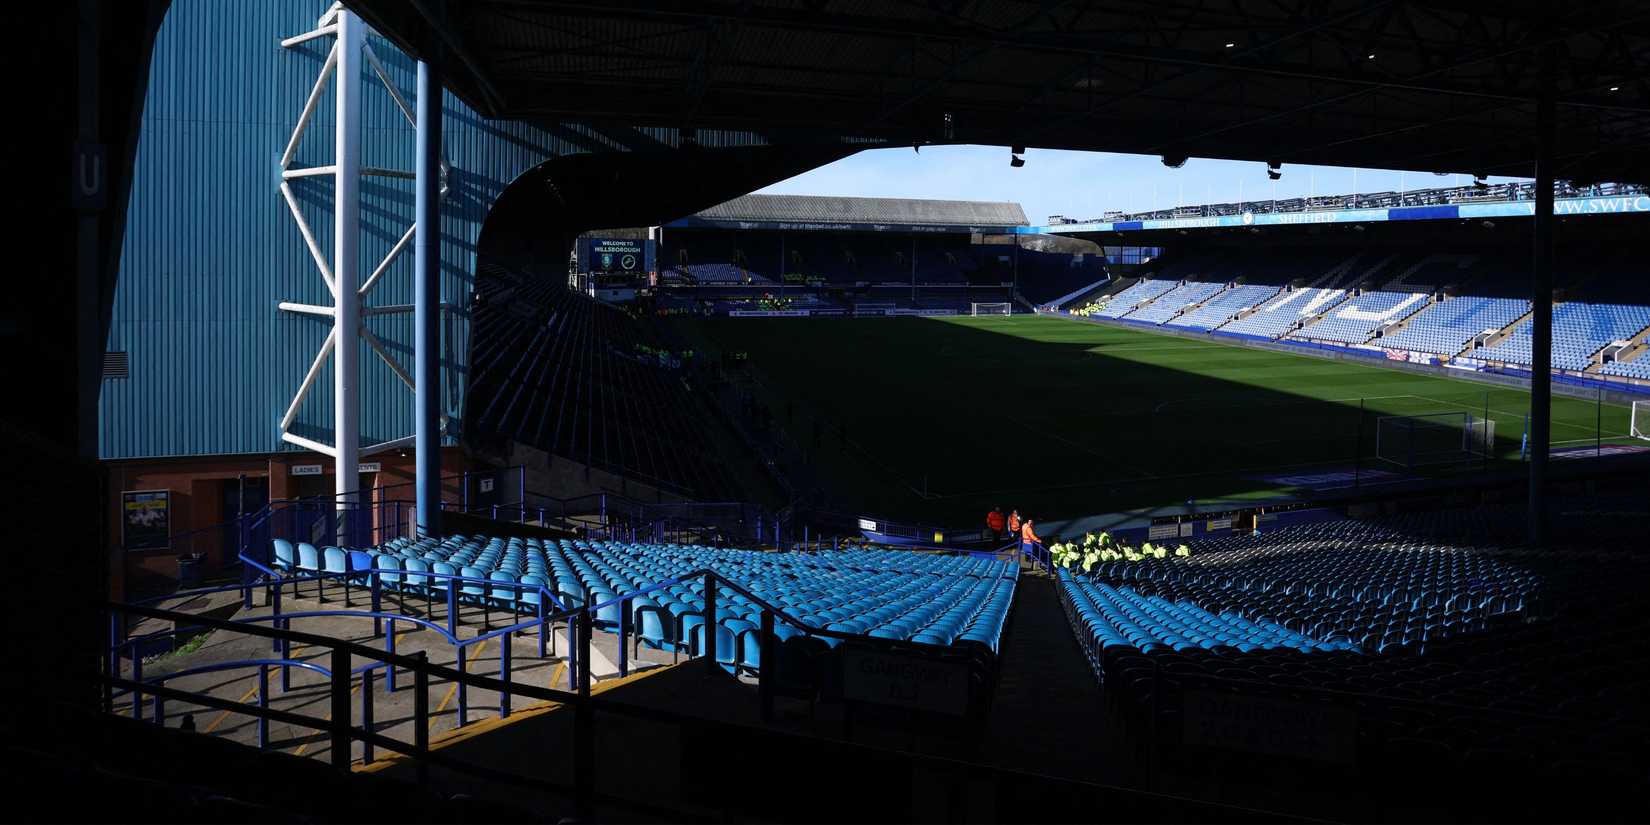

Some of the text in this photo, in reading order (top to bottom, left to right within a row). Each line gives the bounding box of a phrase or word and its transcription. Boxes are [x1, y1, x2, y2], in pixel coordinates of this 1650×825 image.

[80, 152, 99, 195] U
[1280, 213, 1336, 223] SHEFFIELD
[483, 480, 491, 489] T
